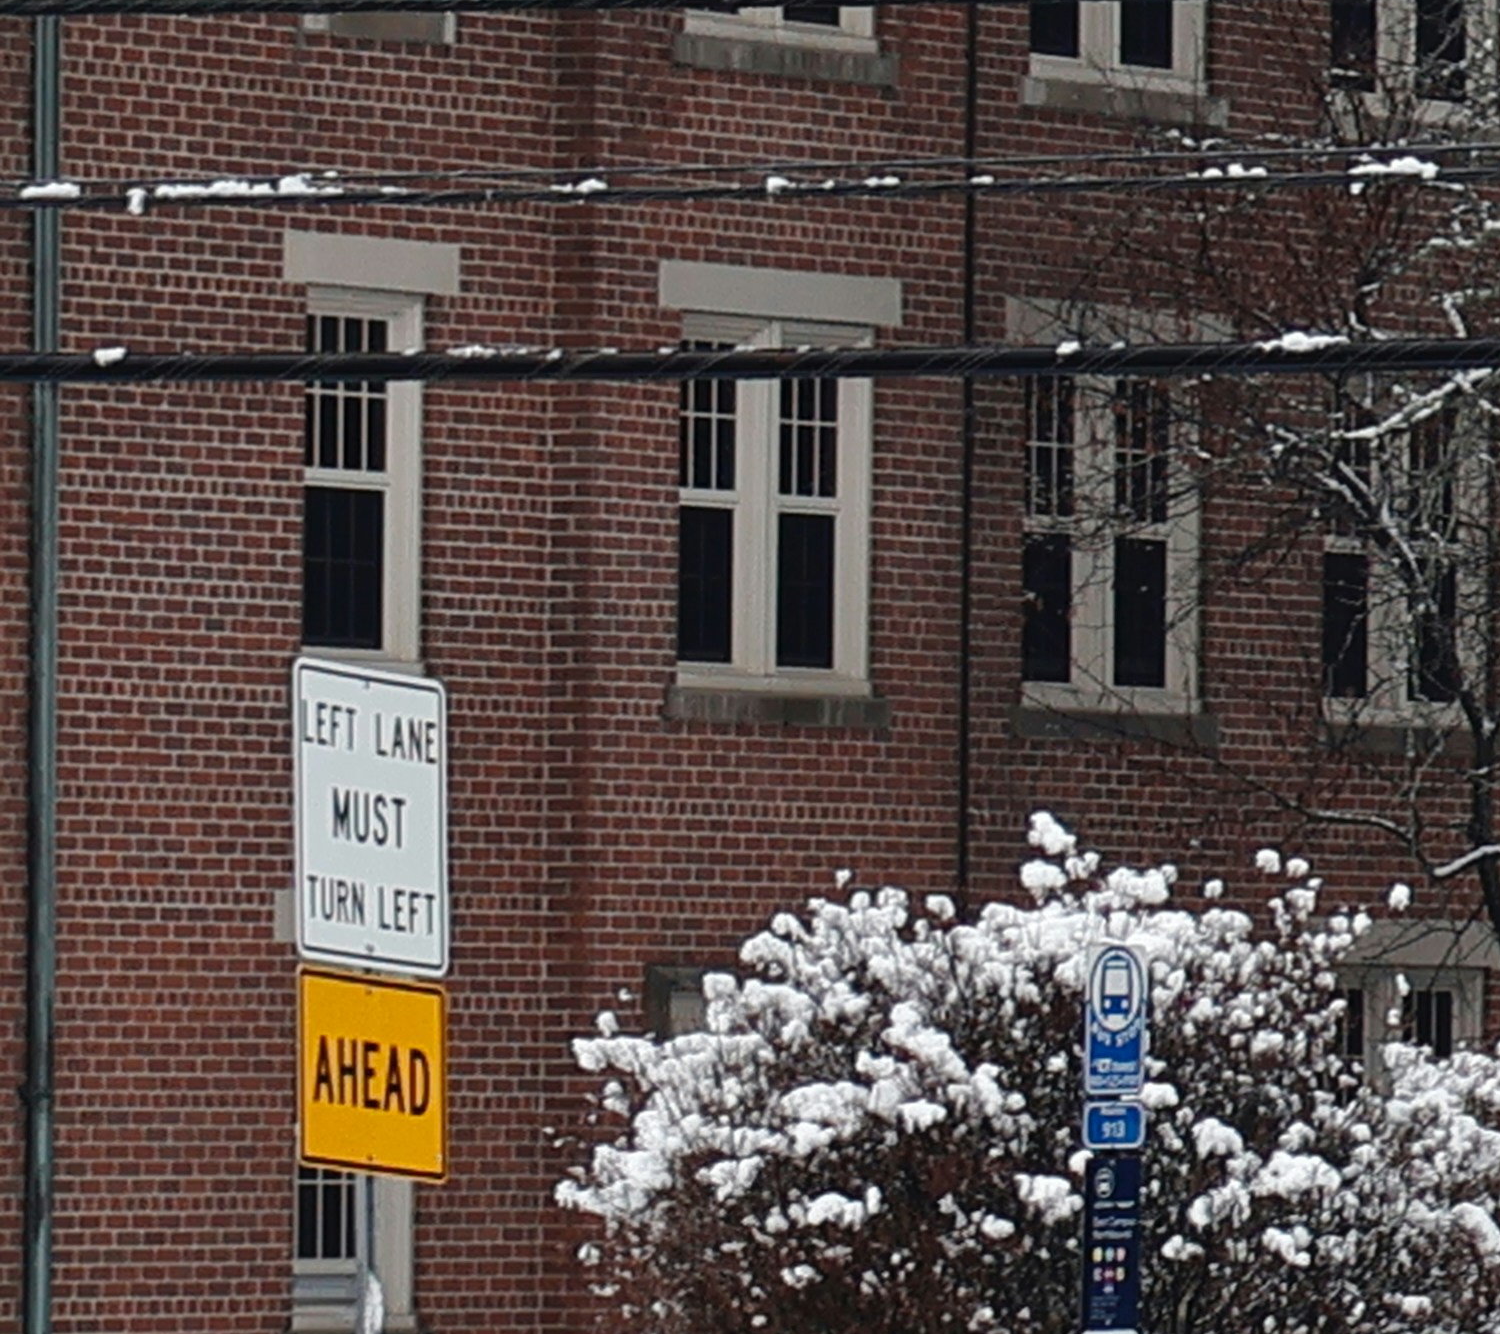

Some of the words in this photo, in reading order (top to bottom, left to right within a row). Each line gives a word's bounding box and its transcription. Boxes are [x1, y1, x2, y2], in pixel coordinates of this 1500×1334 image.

[301, 699, 356, 751] LEFT
[376, 713, 437, 764] LANE
[332, 787, 405, 849] MUST
[307, 875, 365, 925] TURN
[377, 886, 436, 935] LEFT
[313, 1035, 430, 1116] AHEAD
